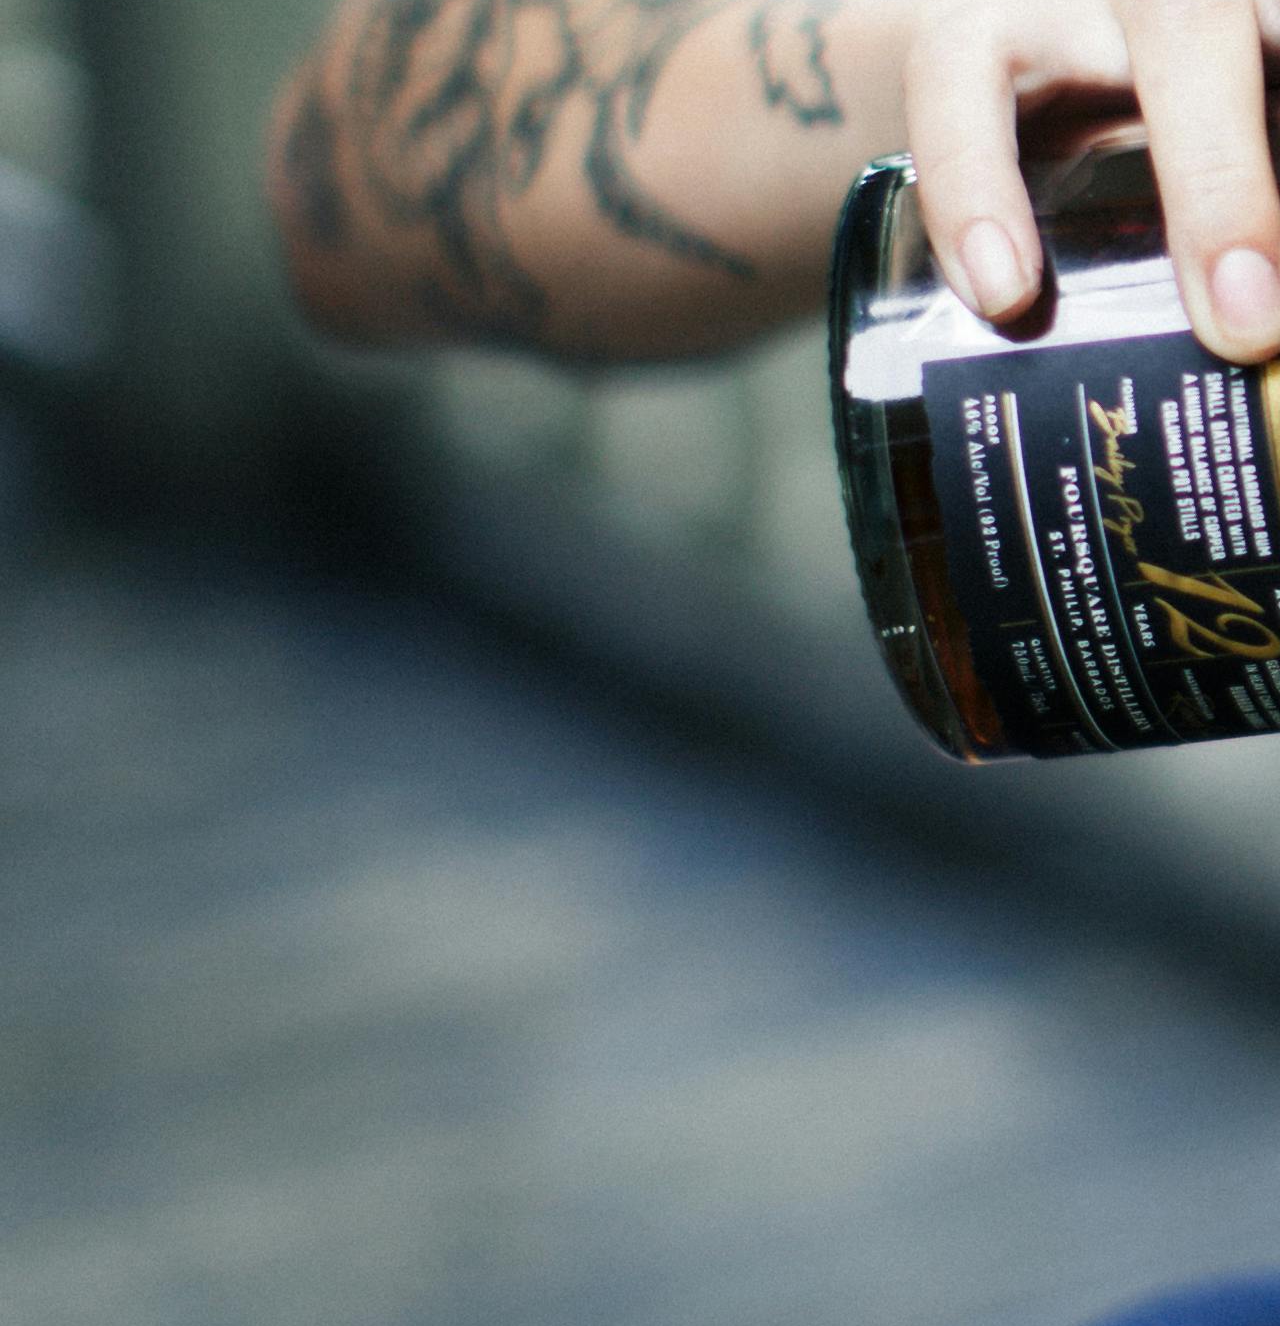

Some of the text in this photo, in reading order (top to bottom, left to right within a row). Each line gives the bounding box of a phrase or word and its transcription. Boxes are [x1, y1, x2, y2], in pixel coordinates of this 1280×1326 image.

[983, 394, 999, 445] PROOF
[1121, 377, 1137, 434] FOUNDER
[1162, 400, 1183, 454] COLUMN
[1172, 469, 1191, 494] POT
[1181, 371, 1225, 560] A UNIQUE BALANCE OF COPPER
[1204, 371, 1247, 555] SMALL BATCH CRAFTED WITH
[1229, 378, 1253, 461] TRADITIONAL
[1241, 464, 1265, 528] BARBADOS
[1253, 530, 1271, 557] RUM
[962, 397, 1009, 589] 46% Alc/Vol (92 Proof)
[1177, 496, 1200, 541] STILLS
[1048, 529, 1065, 559] ST.
[1056, 568, 1084, 631] PHILIP,
[1058, 464, 1151, 731] FOURSQUARE DISTILLERY
[1132, 603, 1155, 648] YEARS
[1030, 638, 1057, 691] QUANTITY
[1076, 639, 1114, 710] BARBADOS
